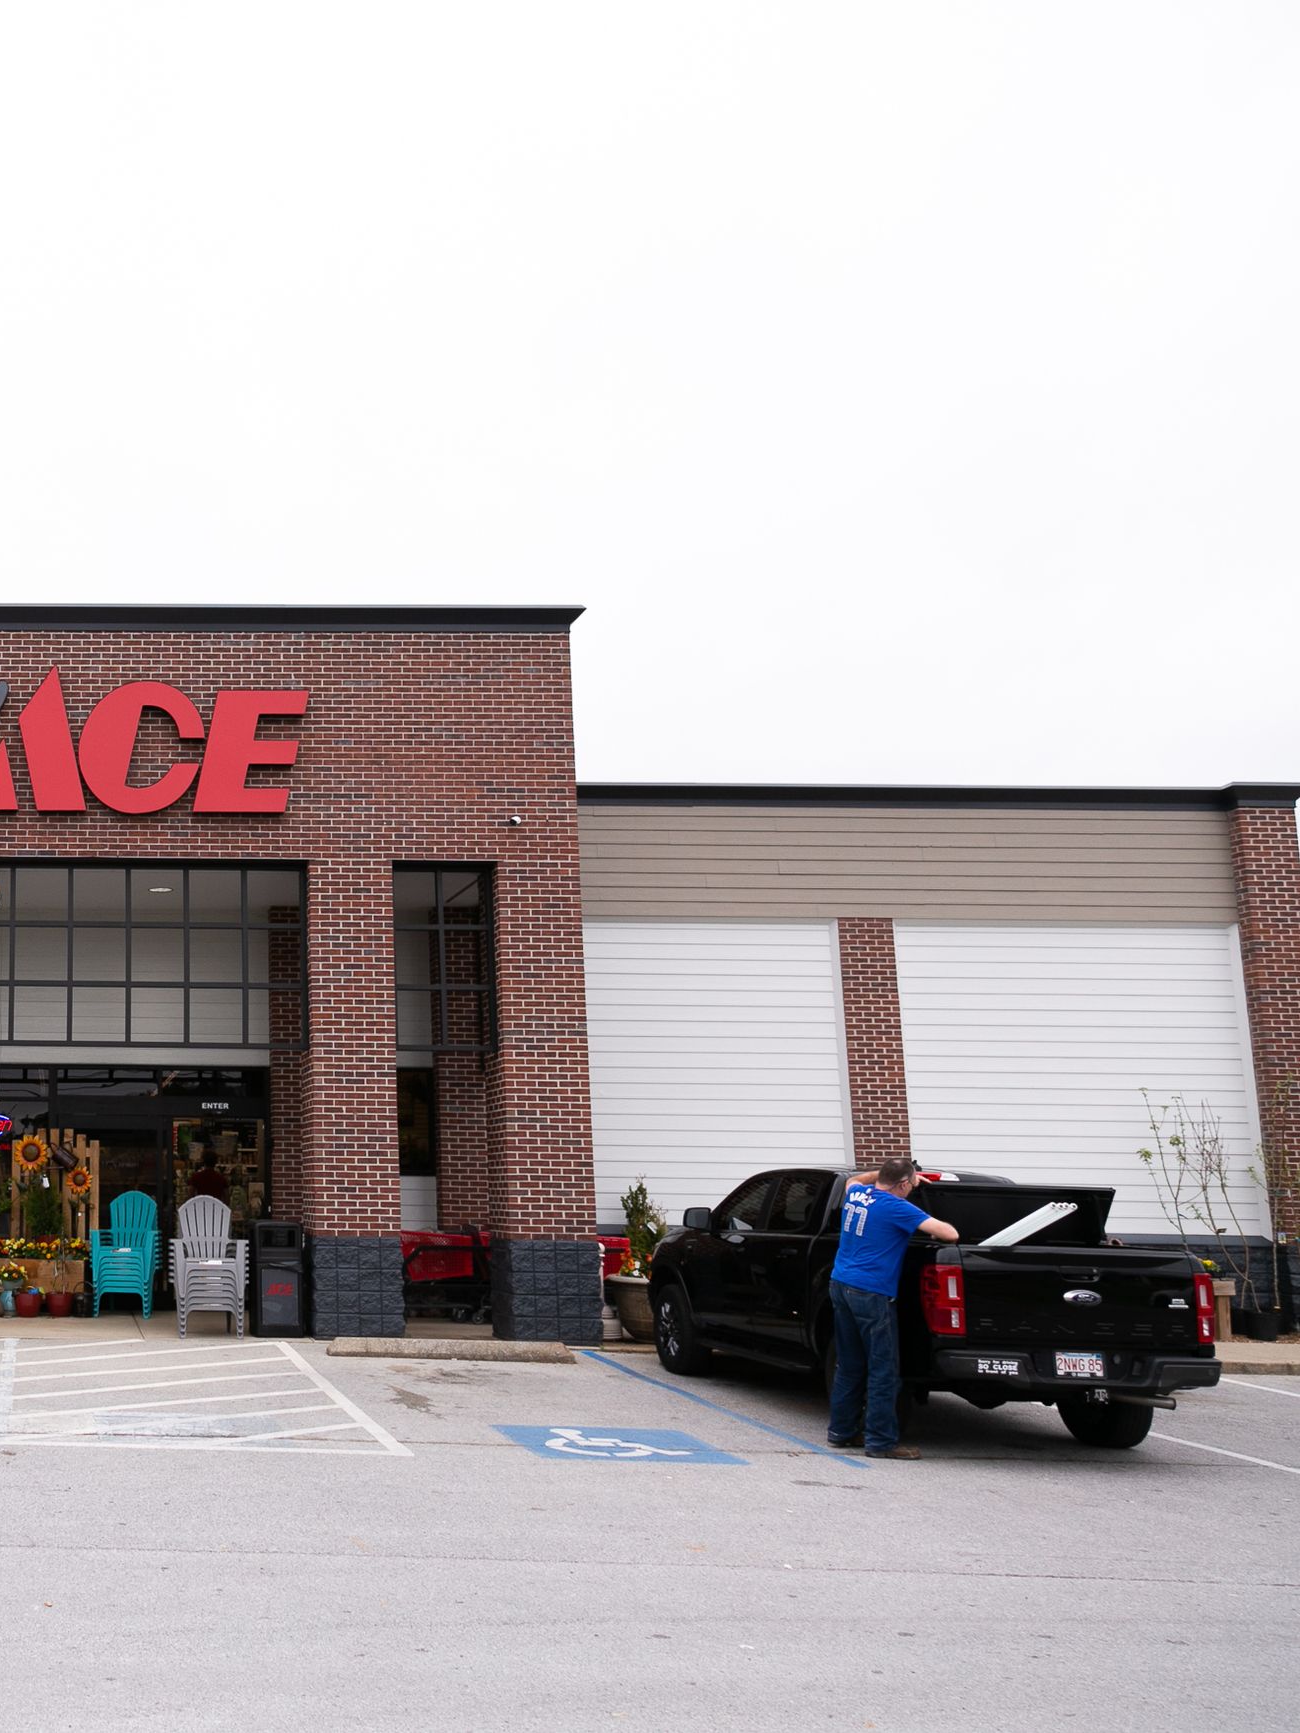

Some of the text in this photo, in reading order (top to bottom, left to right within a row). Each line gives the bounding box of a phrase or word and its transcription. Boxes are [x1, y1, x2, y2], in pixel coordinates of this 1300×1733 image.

[844, 1202, 868, 1236] 77
[266, 1282, 294, 1297] ACE
[1057, 1357, 1103, 1372] 2NWG 85
